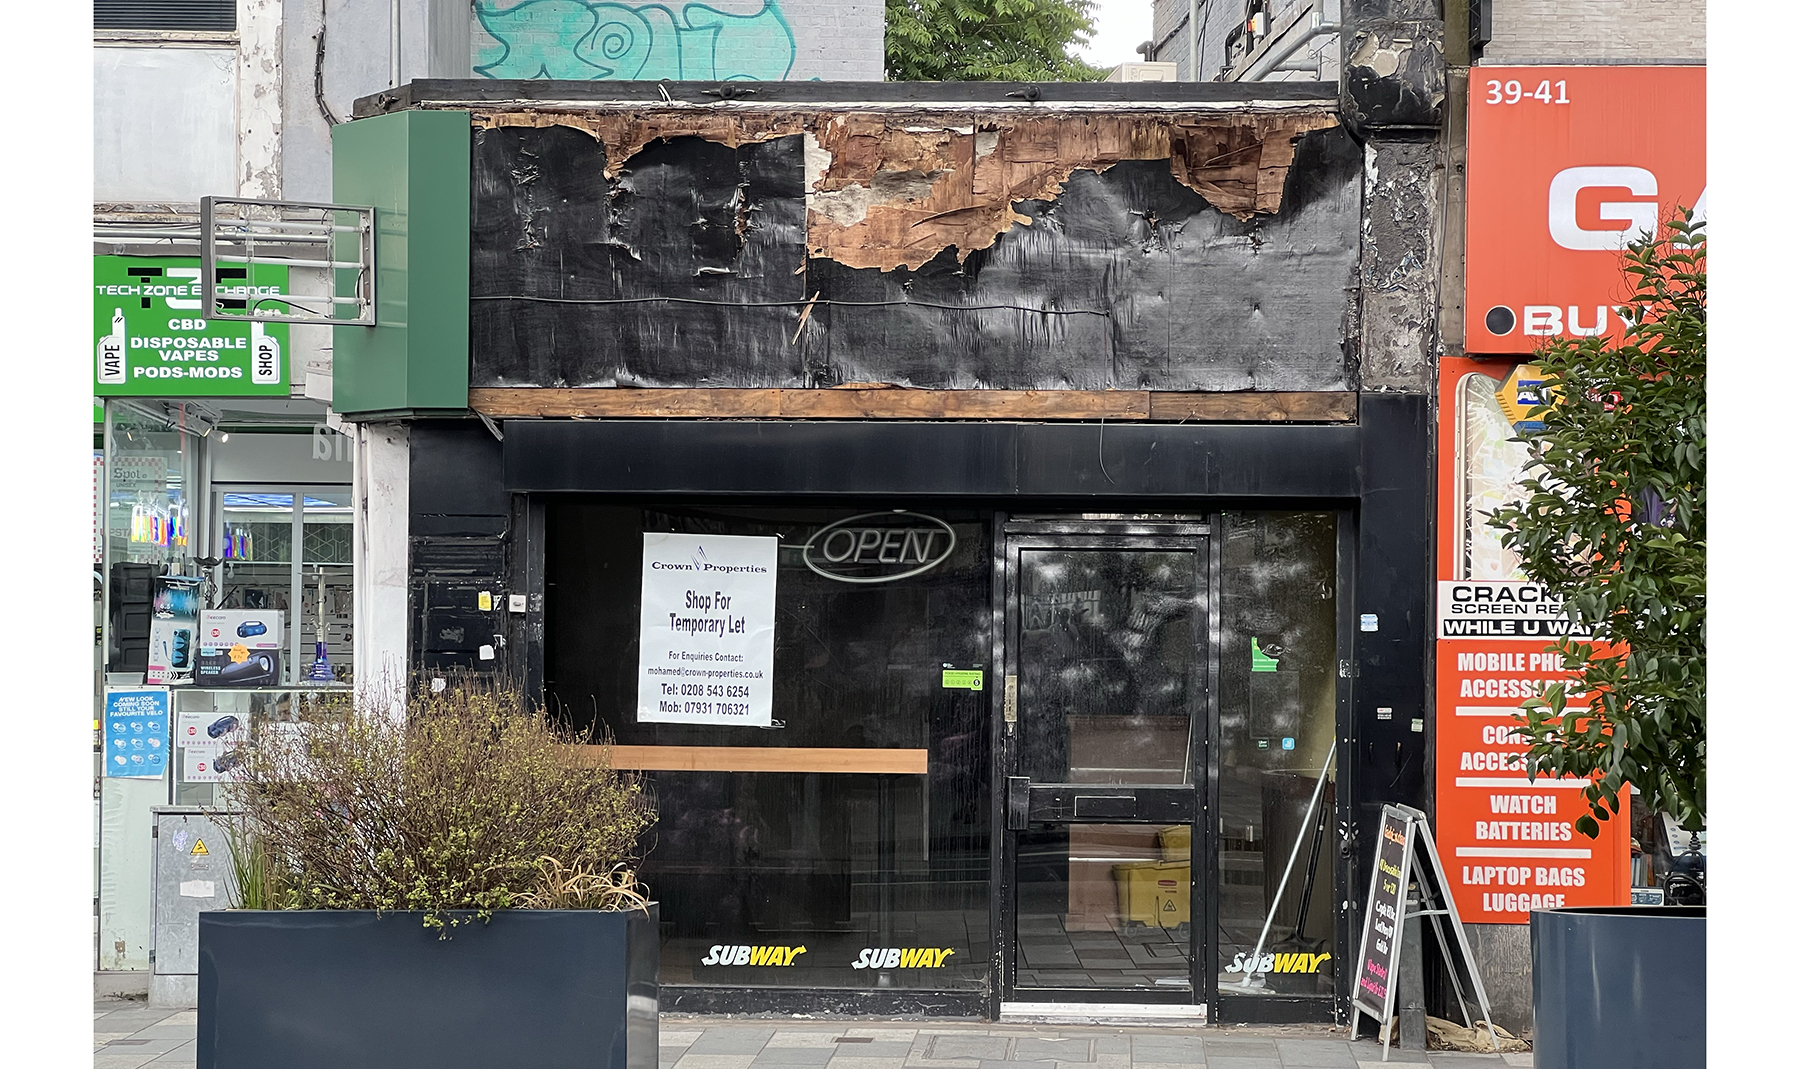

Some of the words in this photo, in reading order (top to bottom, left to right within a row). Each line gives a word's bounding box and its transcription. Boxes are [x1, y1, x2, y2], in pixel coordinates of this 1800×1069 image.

[1485, 79, 1571, 105] 39-41
[95, 285, 141, 295] TECH
[143, 285, 188, 296] ZONE
[191, 285, 280, 296] ECHANGE
[167, 318, 207, 331] CBD
[130, 337, 247, 349] DISPOSABLE
[104, 344, 120, 376] VAPE
[158, 350, 219, 362] VAPES
[258, 344, 273, 376] SHOP
[133, 367, 243, 379] PODS-MODS
[823, 529, 936, 563] OPEN
[651, 561, 693, 571] Crown
[703, 563, 768, 574] Properties
[685, 589, 711, 614] Shop
[714, 591, 732, 610] For
[1452, 586, 1566, 603] CRACK
[1451, 603, 1528, 614] SCREEN
[669, 612, 726, 637] Temporary
[728, 614, 745, 634] Let
[1444, 620, 1516, 635] WHILE
[1522, 620, 1540, 635] U
[668, 650, 680, 660] For
[681, 651, 713, 663] Enquiries
[714, 652, 744, 662] Contact:
[1457, 652, 1526, 672] MOBILE
[1529, 653, 1589, 673] PHO
[647, 666, 764, 679] mohamed@crown-properties.co.uk
[661, 683, 678, 695] Tel:
[680, 683, 704, 696] 0208
[706, 684, 724, 697] 543
[726, 685, 750, 698] 6254
[659, 700, 682, 713] Mob:
[684, 701, 712, 714] 07931
[716, 702, 749, 716] 706321
[1489, 794, 1557, 815] WATCH
[1475, 821, 1572, 842] BATTERIES
[1462, 865, 1532, 886] LAPTOP
[1535, 866, 1586, 887] BAGS
[1482, 892, 1566, 912] LUGGAGE
[701, 945, 807, 967] SUBWAY
[851, 947, 956, 970] SUBWAY
[1224, 951, 1332, 973] SUBWAY
